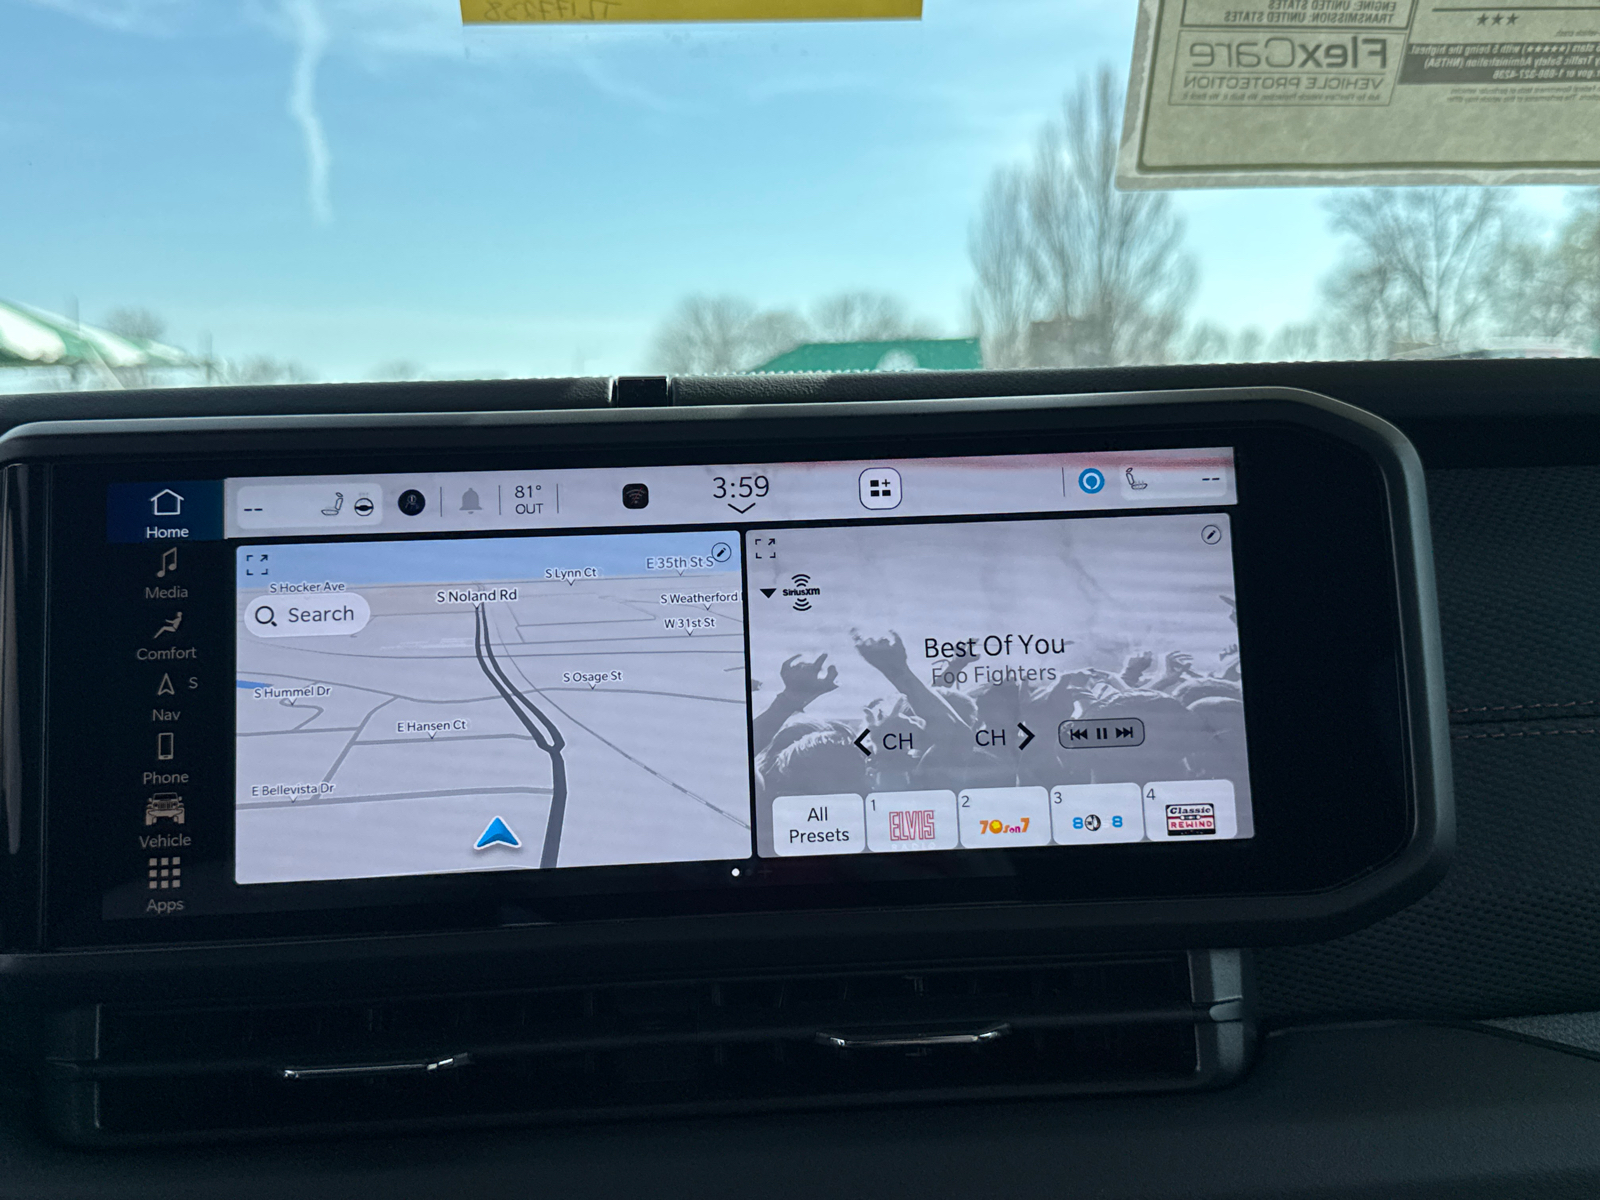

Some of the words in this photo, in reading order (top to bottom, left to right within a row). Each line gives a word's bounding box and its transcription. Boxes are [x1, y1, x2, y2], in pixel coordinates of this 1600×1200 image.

[514, 485, 542, 499] 81°
[712, 475, 770, 499] 3:59
[515, 503, 544, 515] OUT
[146, 526, 190, 539] Home
[646, 558, 654, 569] E
[658, 557, 687, 568] 35th
[690, 556, 703, 567] St
[706, 556, 714, 567] S
[545, 568, 552, 579] S
[555, 568, 582, 581] Lynn
[584, 567, 597, 578] Ct
[145, 585, 189, 599] Media
[270, 583, 277, 593] S
[280, 582, 320, 593] Hocker
[323, 581, 345, 592] Ave
[437, 591, 445, 603] S
[448, 589, 496, 602] Noland
[500, 588, 517, 601] Rd
[661, 594, 667, 604] S
[670, 592, 738, 603] Weatherford
[288, 605, 355, 623] Search
[664, 619, 675, 629] W
[678, 618, 701, 628] 31st
[704, 617, 716, 628] St
[924, 638, 977, 659] Best
[983, 634, 1013, 657] Of
[1018, 634, 1065, 655] You
[136, 647, 197, 660] Comfort
[563, 672, 570, 683] S
[573, 671, 608, 684] Osage
[611, 671, 623, 682] St
[932, 667, 968, 685] Foo
[974, 665, 1057, 687] Fighters
[189, 677, 198, 689] S
[254, 688, 261, 698] S
[264, 686, 314, 698] Hummel
[317, 686, 331, 697] Dr
[152, 709, 181, 721] Nav
[397, 723, 404, 732] E
[407, 722, 451, 732] Hansen
[453, 720, 466, 730] Ct
[882, 732, 914, 750] CH
[975, 729, 1006, 747] CH
[143, 772, 190, 785] Phone
[252, 786, 259, 796] E
[262, 784, 317, 796] Bellevista
[320, 783, 335, 794] Dr
[1146, 788, 1156, 801] 4
[961, 795, 971, 808] 2
[1054, 791, 1063, 804] 3
[870, 799, 877, 811] 1
[1169, 806, 1211, 815] Classic
[807, 806, 828, 822] All
[889, 809, 935, 842] ELVIS
[1170, 820, 1213, 829] REWIND
[139, 834, 192, 848] Vehicle
[789, 828, 850, 843] Presets
[147, 899, 185, 914] Apps
